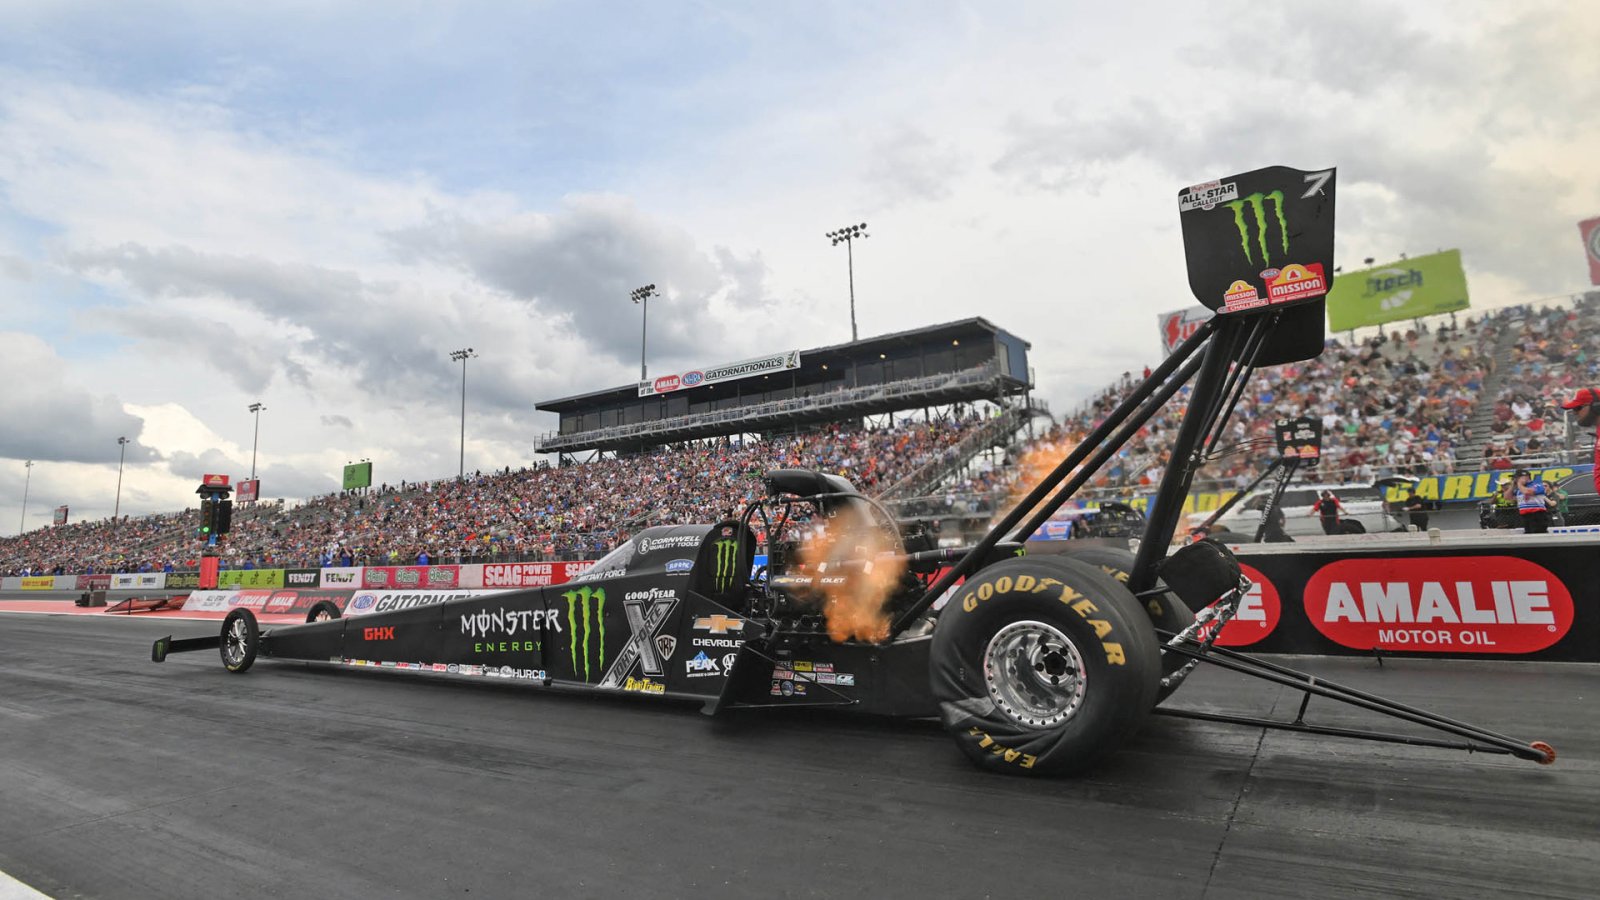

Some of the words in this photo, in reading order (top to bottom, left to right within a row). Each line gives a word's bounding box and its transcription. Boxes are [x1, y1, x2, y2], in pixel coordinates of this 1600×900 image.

[1302, 170, 1333, 199] 7
[1192, 195, 1225, 208] CALLOUT
[705, 358, 783, 380] GATORNATIONALS
[651, 536, 700, 545] CORNWELL
[485, 565, 521, 586] SCAG
[523, 565, 552, 574] POWER
[604, 569, 626, 579] FORCE
[288, 573, 316, 583] FENDT
[326, 573, 355, 582] FENDT
[625, 588, 675, 601] GOODYEAR
[1323, 580, 1556, 625] AMALIE
[460, 606, 563, 638] MONSTER
[962, 575, 1127, 666] GOODYEAR
[364, 627, 395, 641] GHX
[1378, 629, 1452, 644] MOTOR
[1459, 631, 1496, 645] OIL
[474, 641, 542, 653] ENERGY
[685, 658, 720, 673] PEAK
[512, 669, 546, 680] HURCO
